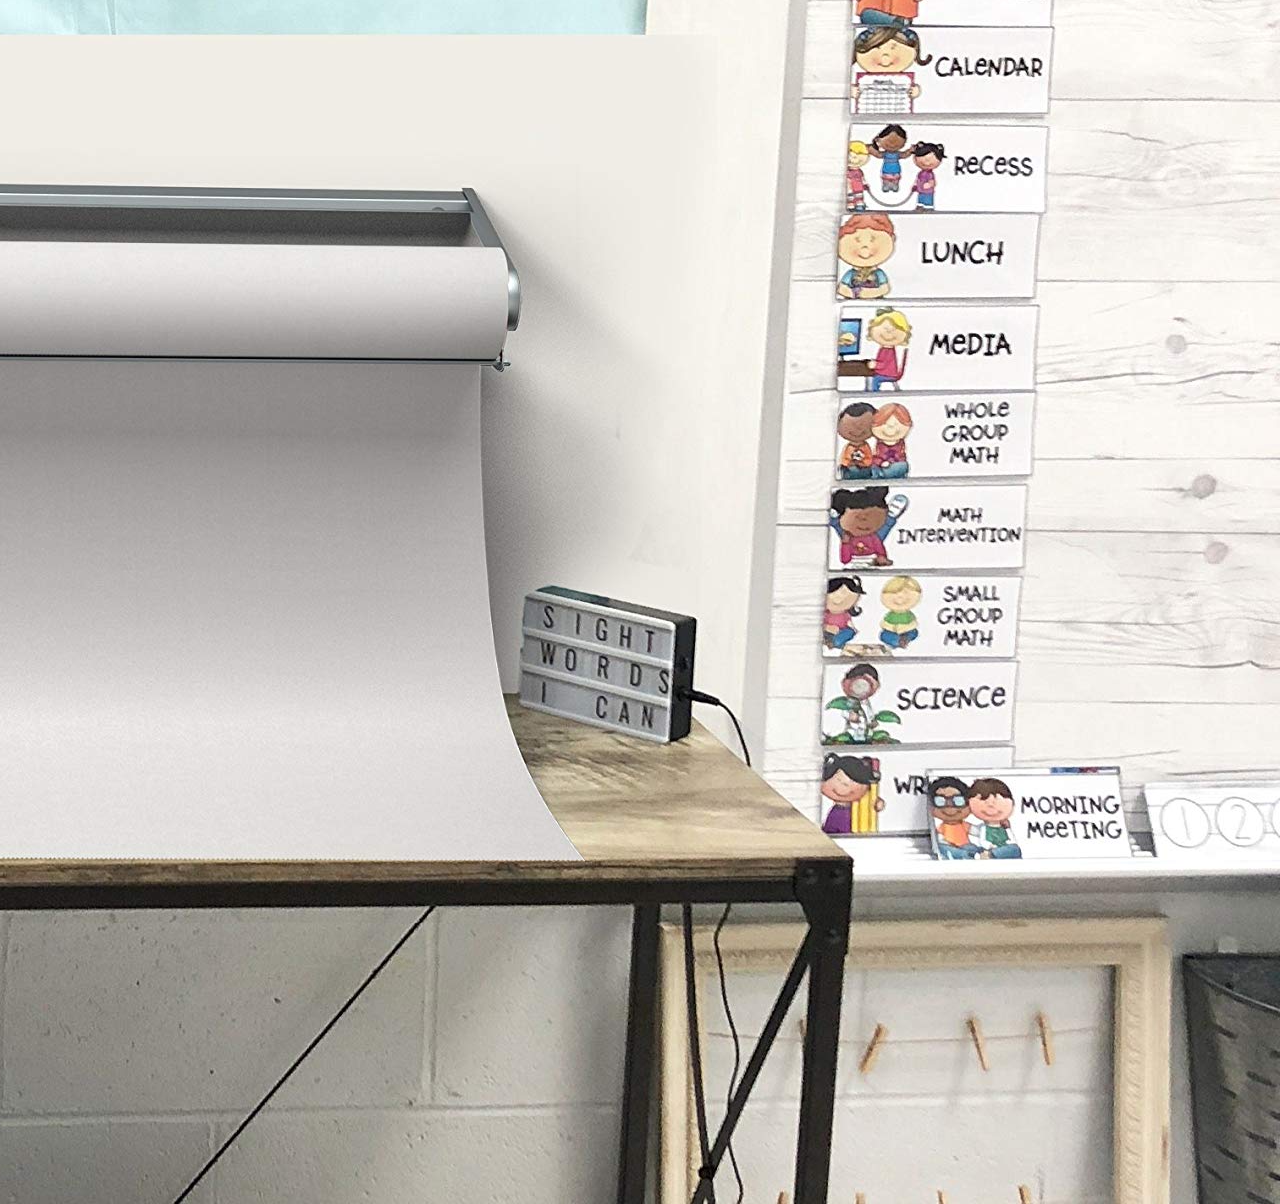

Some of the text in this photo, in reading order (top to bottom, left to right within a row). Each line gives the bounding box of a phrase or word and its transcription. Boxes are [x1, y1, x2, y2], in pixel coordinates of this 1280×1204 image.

[921, 240, 1004, 265] LUNCH
[942, 423, 1009, 443] GROUP
[949, 446, 999, 464] MATH
[937, 507, 983, 523] MATH
[943, 585, 1000, 603] SMALL
[937, 607, 1003, 625] GROUP
[543, 606, 655, 653] SIGHT
[943, 629, 994, 647] MATH
[541, 640, 670, 694] WORDS
[541, 682, 653, 728] I CAN
[1021, 795, 1120, 815] MORNING
